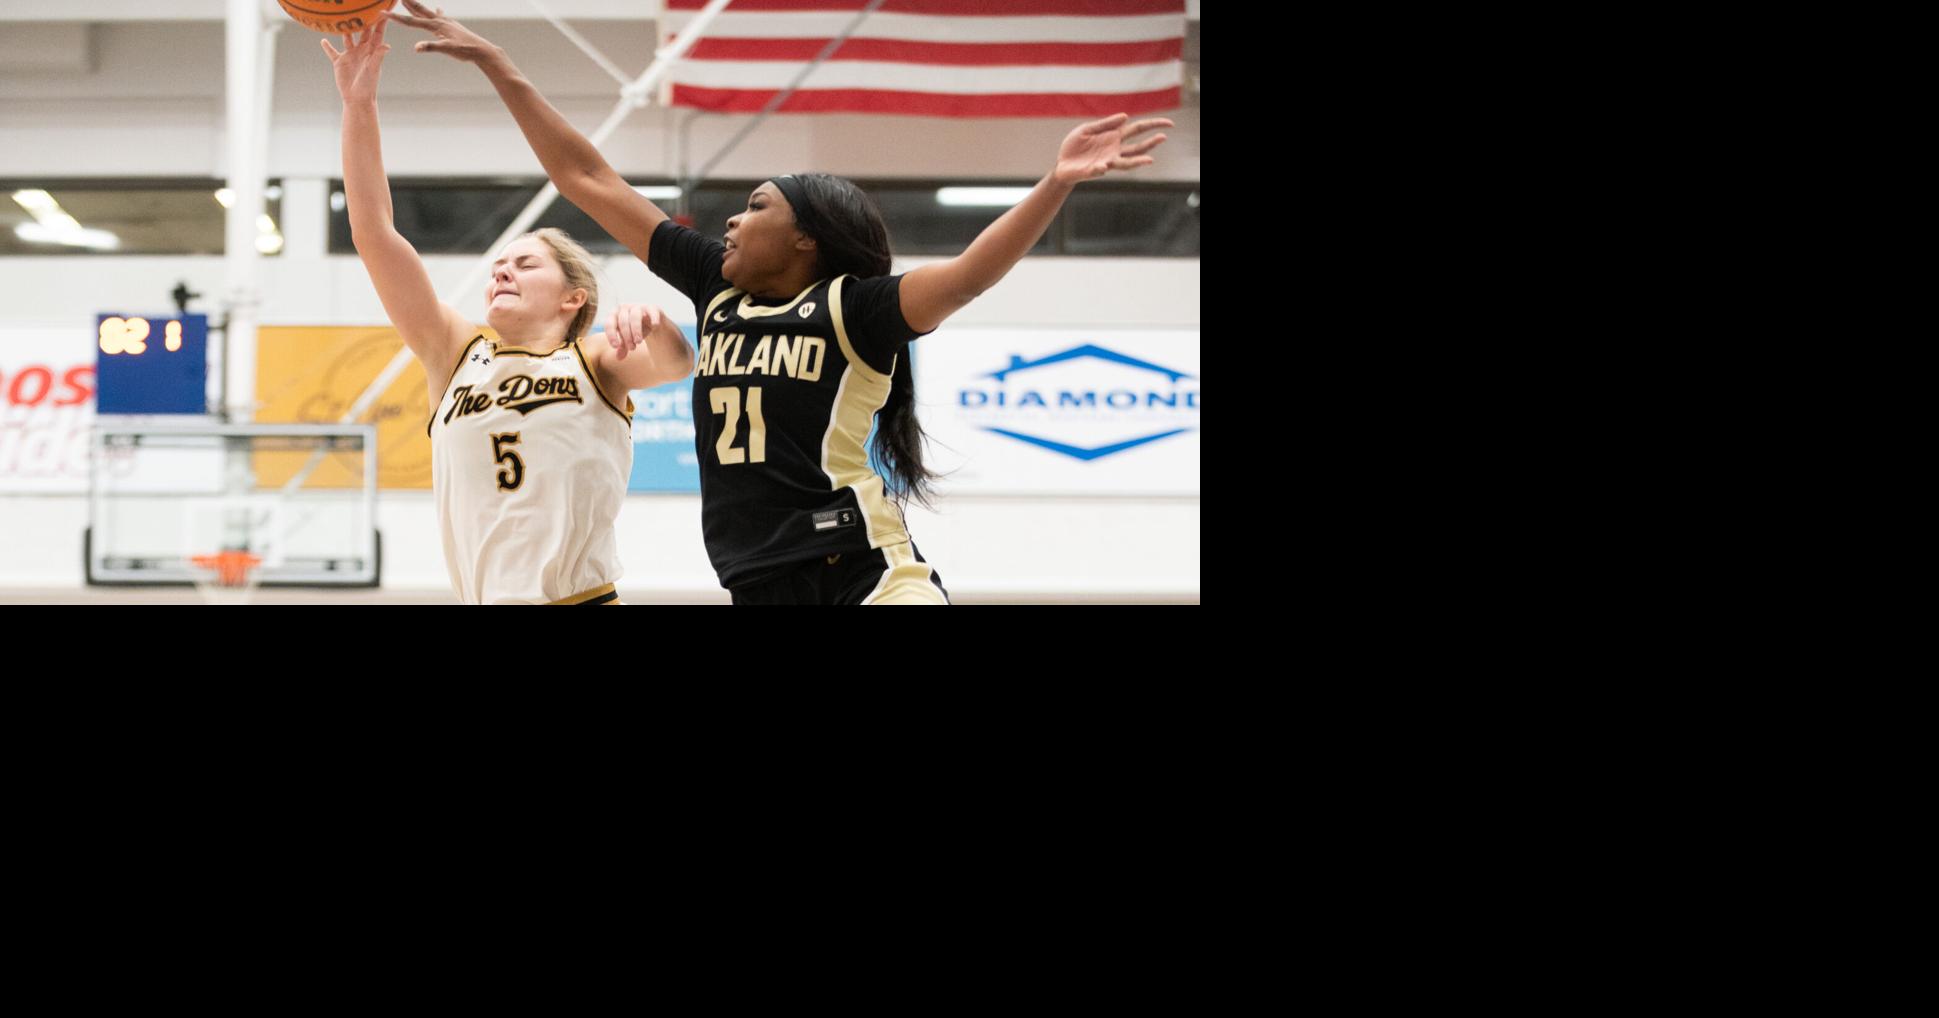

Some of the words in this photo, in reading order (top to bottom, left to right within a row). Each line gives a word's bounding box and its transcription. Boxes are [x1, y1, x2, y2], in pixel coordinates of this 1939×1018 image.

[695, 332, 826, 382] AKLAND
[0, 363, 97, 408] os
[444, 383, 492, 425] The
[496, 374, 583, 415] Dons
[631, 385, 691, 419] ort
[709, 386, 766, 465] 21
[489, 430, 527, 493] 5
